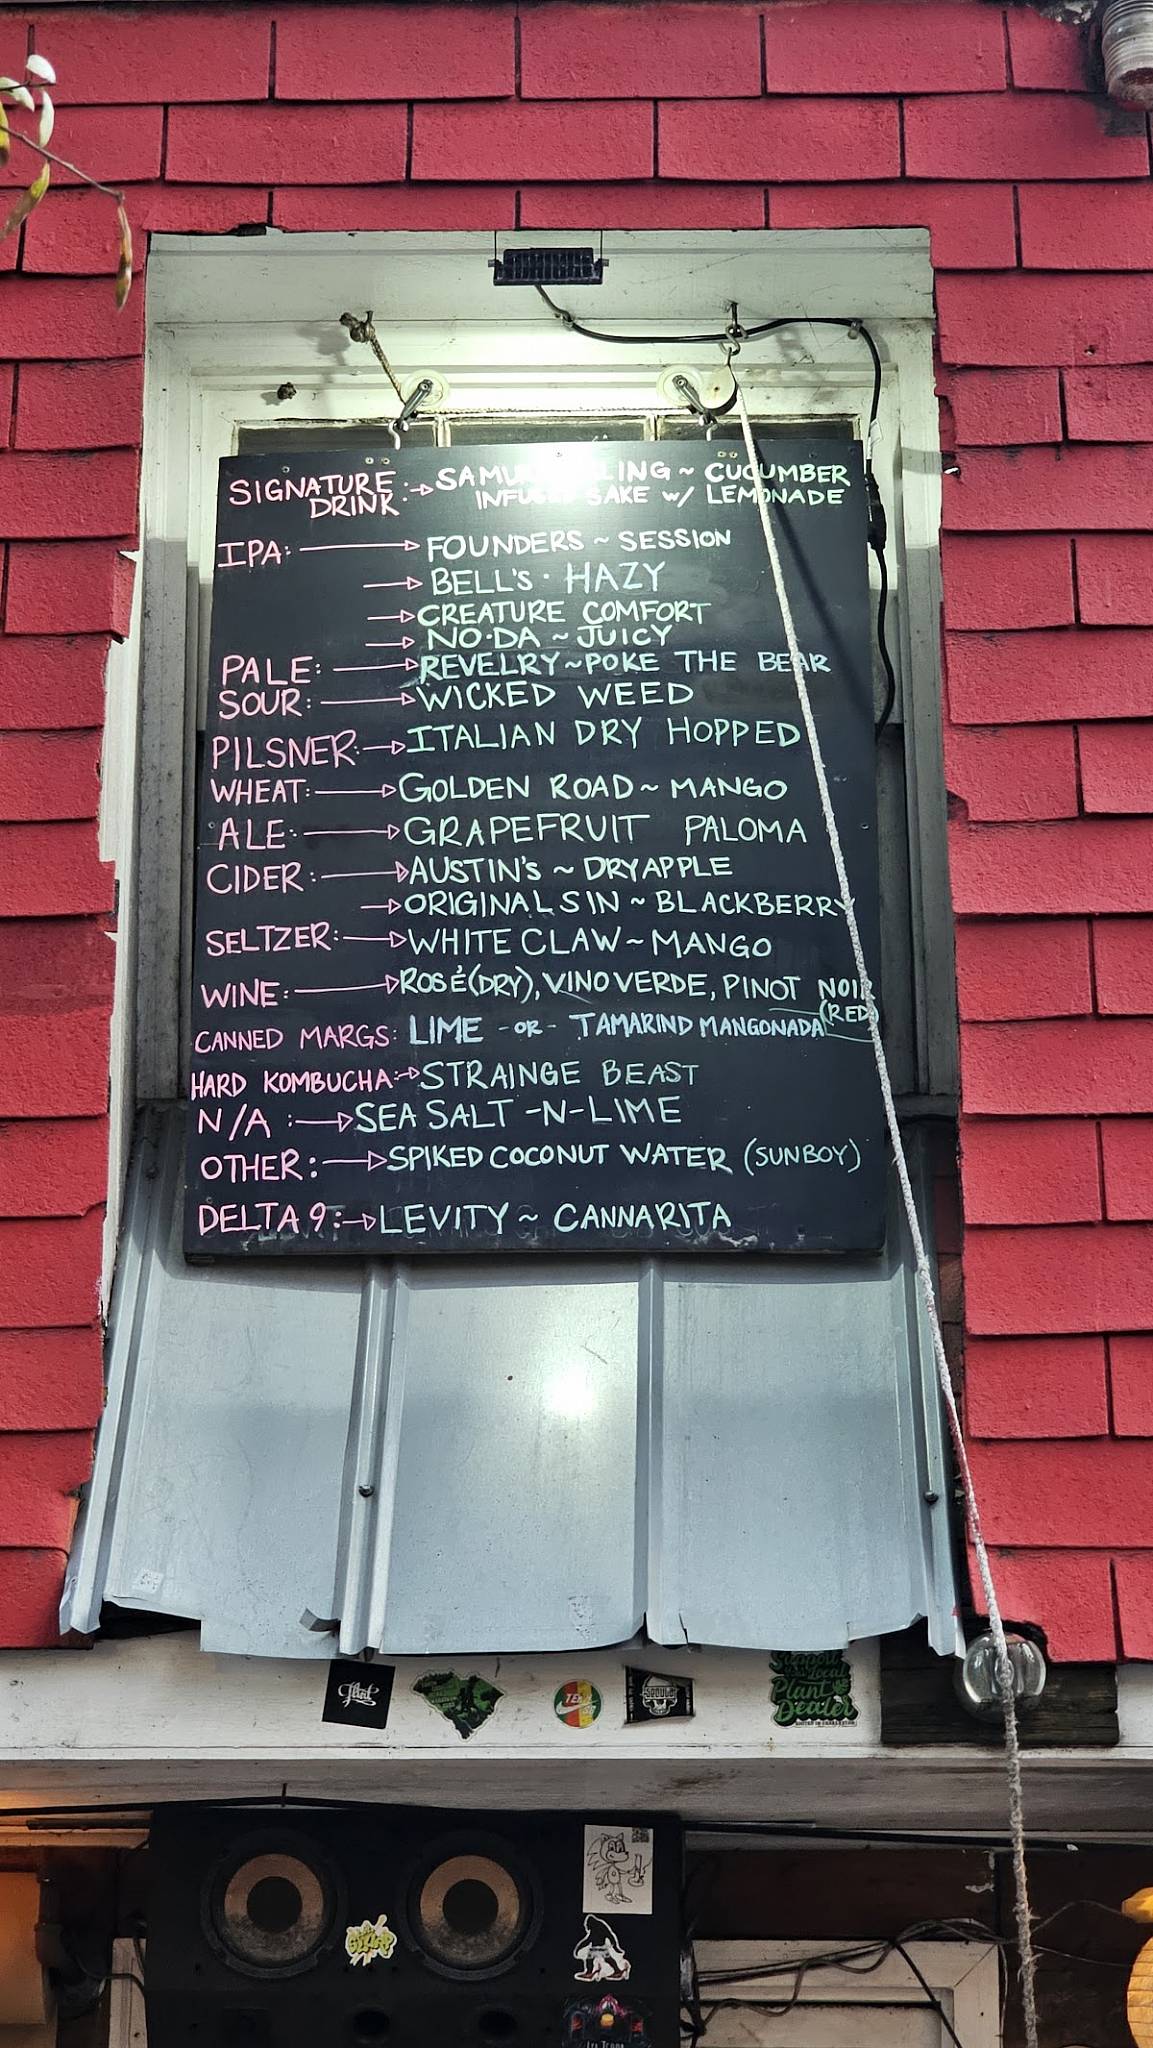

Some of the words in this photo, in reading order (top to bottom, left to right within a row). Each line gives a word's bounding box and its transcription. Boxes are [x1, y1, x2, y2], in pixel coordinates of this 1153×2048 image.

[435, 462, 572, 491] SAMU
[578, 460, 671, 483] LING
[705, 462, 850, 487] CUCUMBER
[586, 485, 650, 506] SAKE
[707, 484, 845, 507] LEMONADE
[218, 540, 291, 568] IPA:
[427, 531, 584, 562] FOUNDERS
[618, 528, 731, 551] SESSION
[566, 560, 666, 594] HAZY
[417, 600, 566, 627] CREATURE
[583, 599, 711, 625] COMFORT
[577, 624, 673, 648] JUICY
[221, 655, 321, 686] PALE:
[418, 651, 560, 683] REVELRY
[585, 652, 660, 674] POKE
[674, 650, 737, 673] THE
[757, 651, 831, 673] BEAR
[219, 687, 312, 719] SOUR:
[416, 680, 556, 712] WICKED
[577, 681, 694, 709] WEED
[212, 729, 360, 771] PILSNER:
[407, 721, 555, 753] ITALIAN
[575, 717, 642, 748] DRY
[668, 717, 801, 747] HOPPED
[210, 778, 311, 806] WHEAT:
[399, 772, 529, 802] GOLDEN
[549, 773, 634, 800] ROAD
[671, 777, 788, 800] MANGO
[218, 817, 298, 851] ALE:
[404, 813, 650, 848] GRAPEFRUIT
[685, 815, 807, 846] PALOMA
[206, 861, 317, 894] CIDER:
[656, 890, 856, 917] BLACKBERRY
[206, 921, 339, 956] SELTZER:
[407, 927, 511, 956] WHITE
[521, 926, 621, 956] CLAW
[652, 929, 772, 959] MANGO
[201, 978, 289, 1009] WINE:
[723, 976, 801, 1000] PINOT
[818, 977, 876, 1000] NOIR
[820, 999, 880, 1026] (RED)
[194, 1028, 284, 1053] CANNED
[300, 1024, 397, 1049] MARGS:
[409, 1014, 484, 1045] LIME
[569, 1012, 693, 1037] TAMARIND
[700, 1016, 825, 1038] MANGONADA
[190, 1071, 246, 1100] HARD
[264, 1068, 399, 1093] KOMBUCHA:
[420, 1060, 580, 1090] STRAINGE
[602, 1060, 700, 1086] BEAST
[355, 1102, 416, 1133] SEA
[426, 1099, 514, 1130] SALT
[200, 1148, 317, 1183] OTHER:
[387, 1146, 483, 1171] SPIKED
[490, 1144, 609, 1169] COCONUT
[619, 1143, 733, 1175] WATER
[745, 1138, 861, 1176] (SUNBOY)
[380, 1202, 509, 1234] LEVITY
[554, 1201, 732, 1232] CANNARITA
[771, 1677, 834, 1702] Plant
[774, 1696, 855, 1722] Dealer
